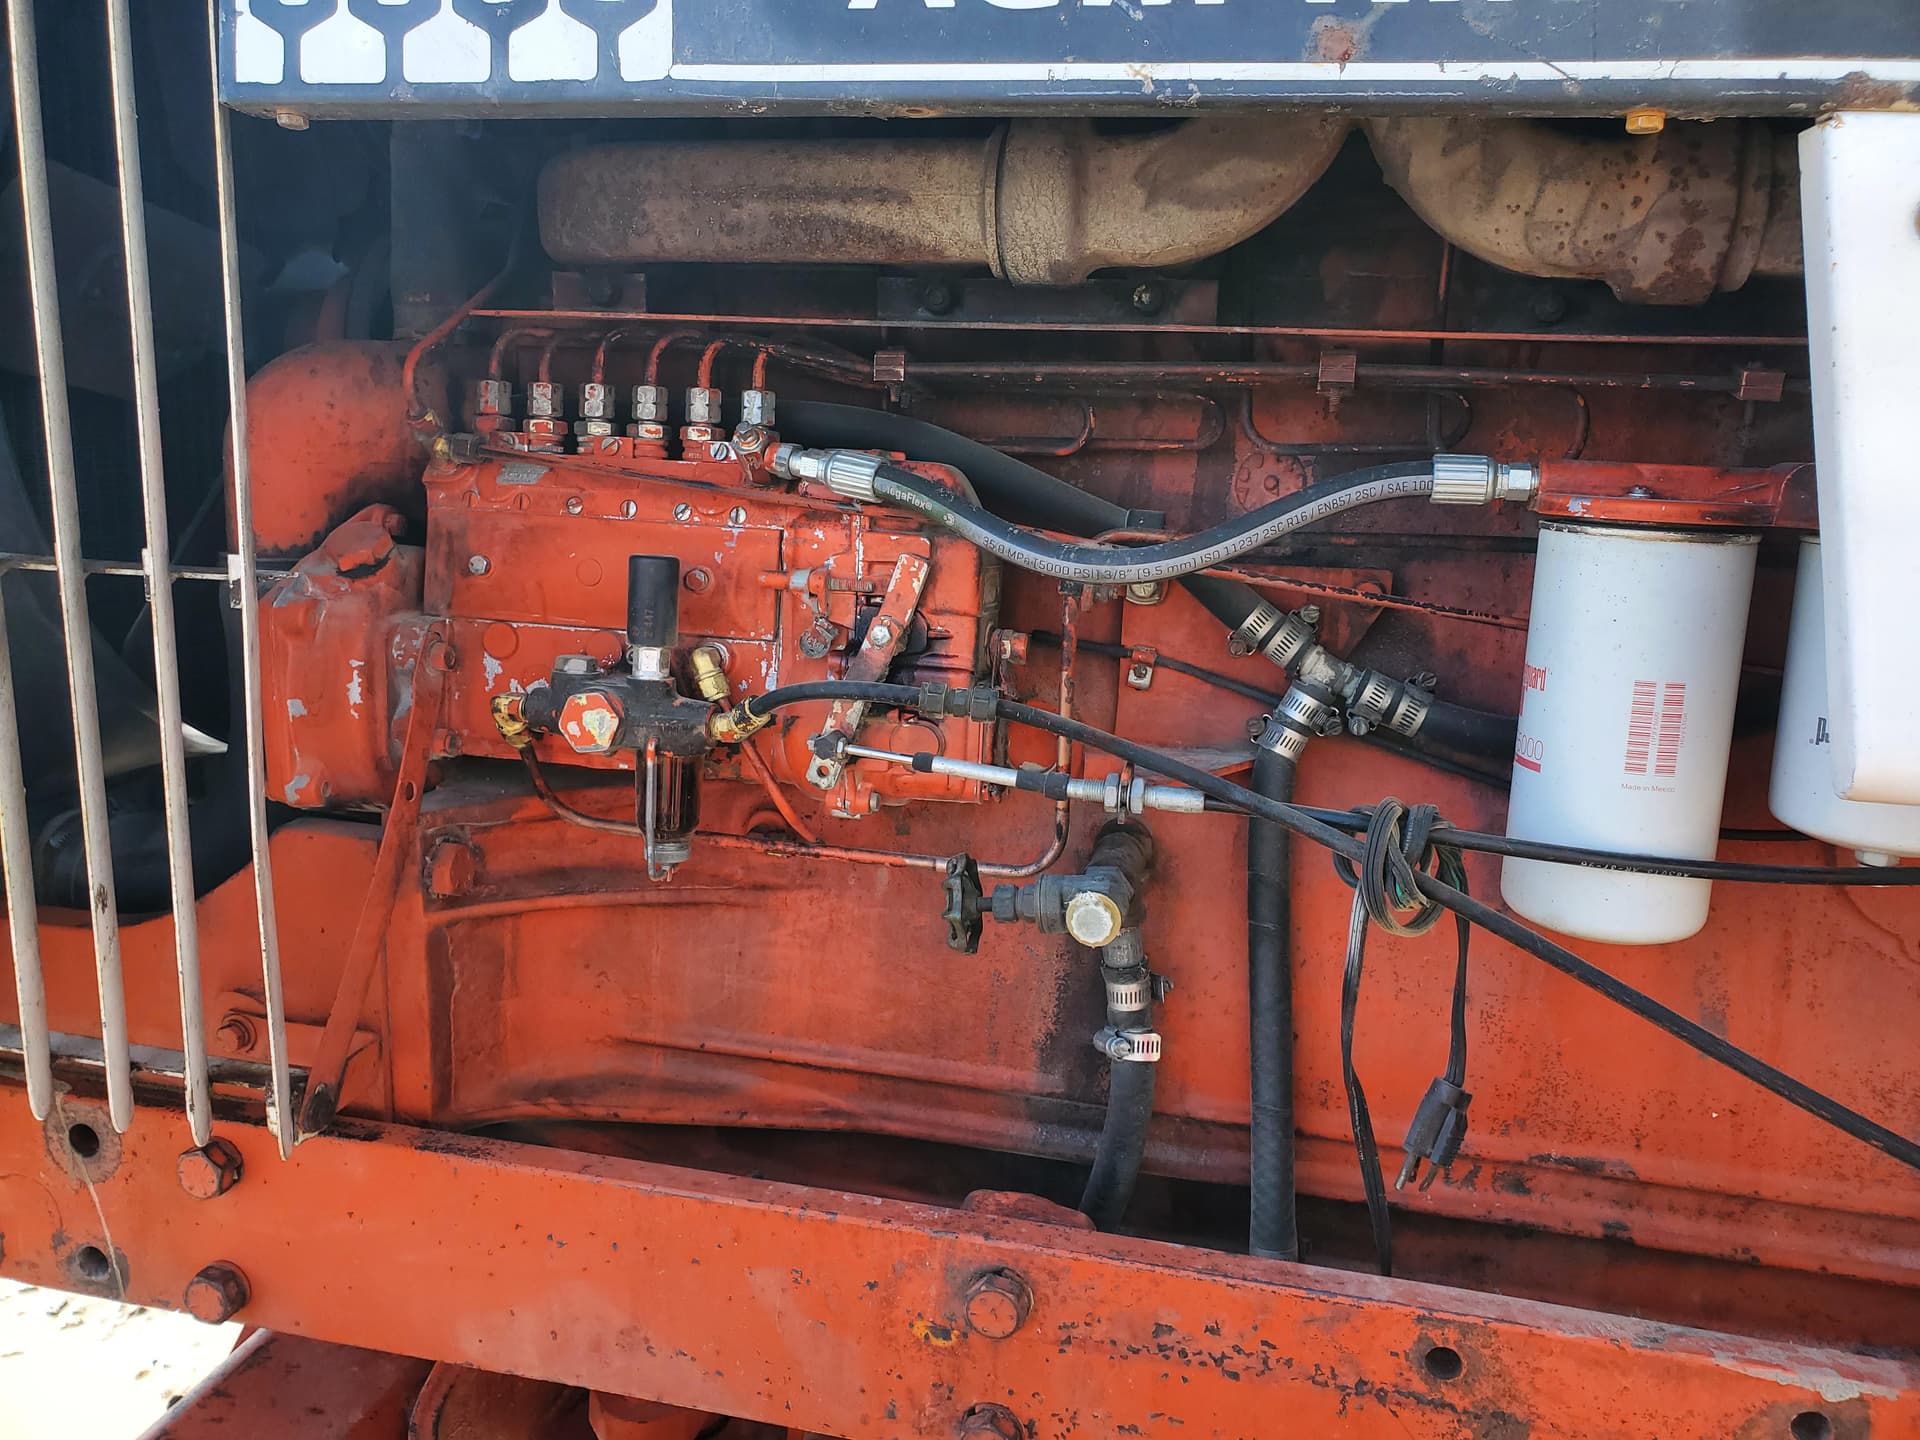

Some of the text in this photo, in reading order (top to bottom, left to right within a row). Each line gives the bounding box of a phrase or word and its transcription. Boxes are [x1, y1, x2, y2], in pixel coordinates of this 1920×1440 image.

[1007, 547, 1030, 565] MPa
[1201, 550, 1220, 564] ISO
[1224, 533, 1259, 556] 11237
[1262, 523, 1285, 539] 2SC
[1287, 511, 1308, 528] R16
[1318, 494, 1352, 515] EN857
[1355, 487, 1377, 501] 2SC
[1387, 482, 1408, 494] SAE
